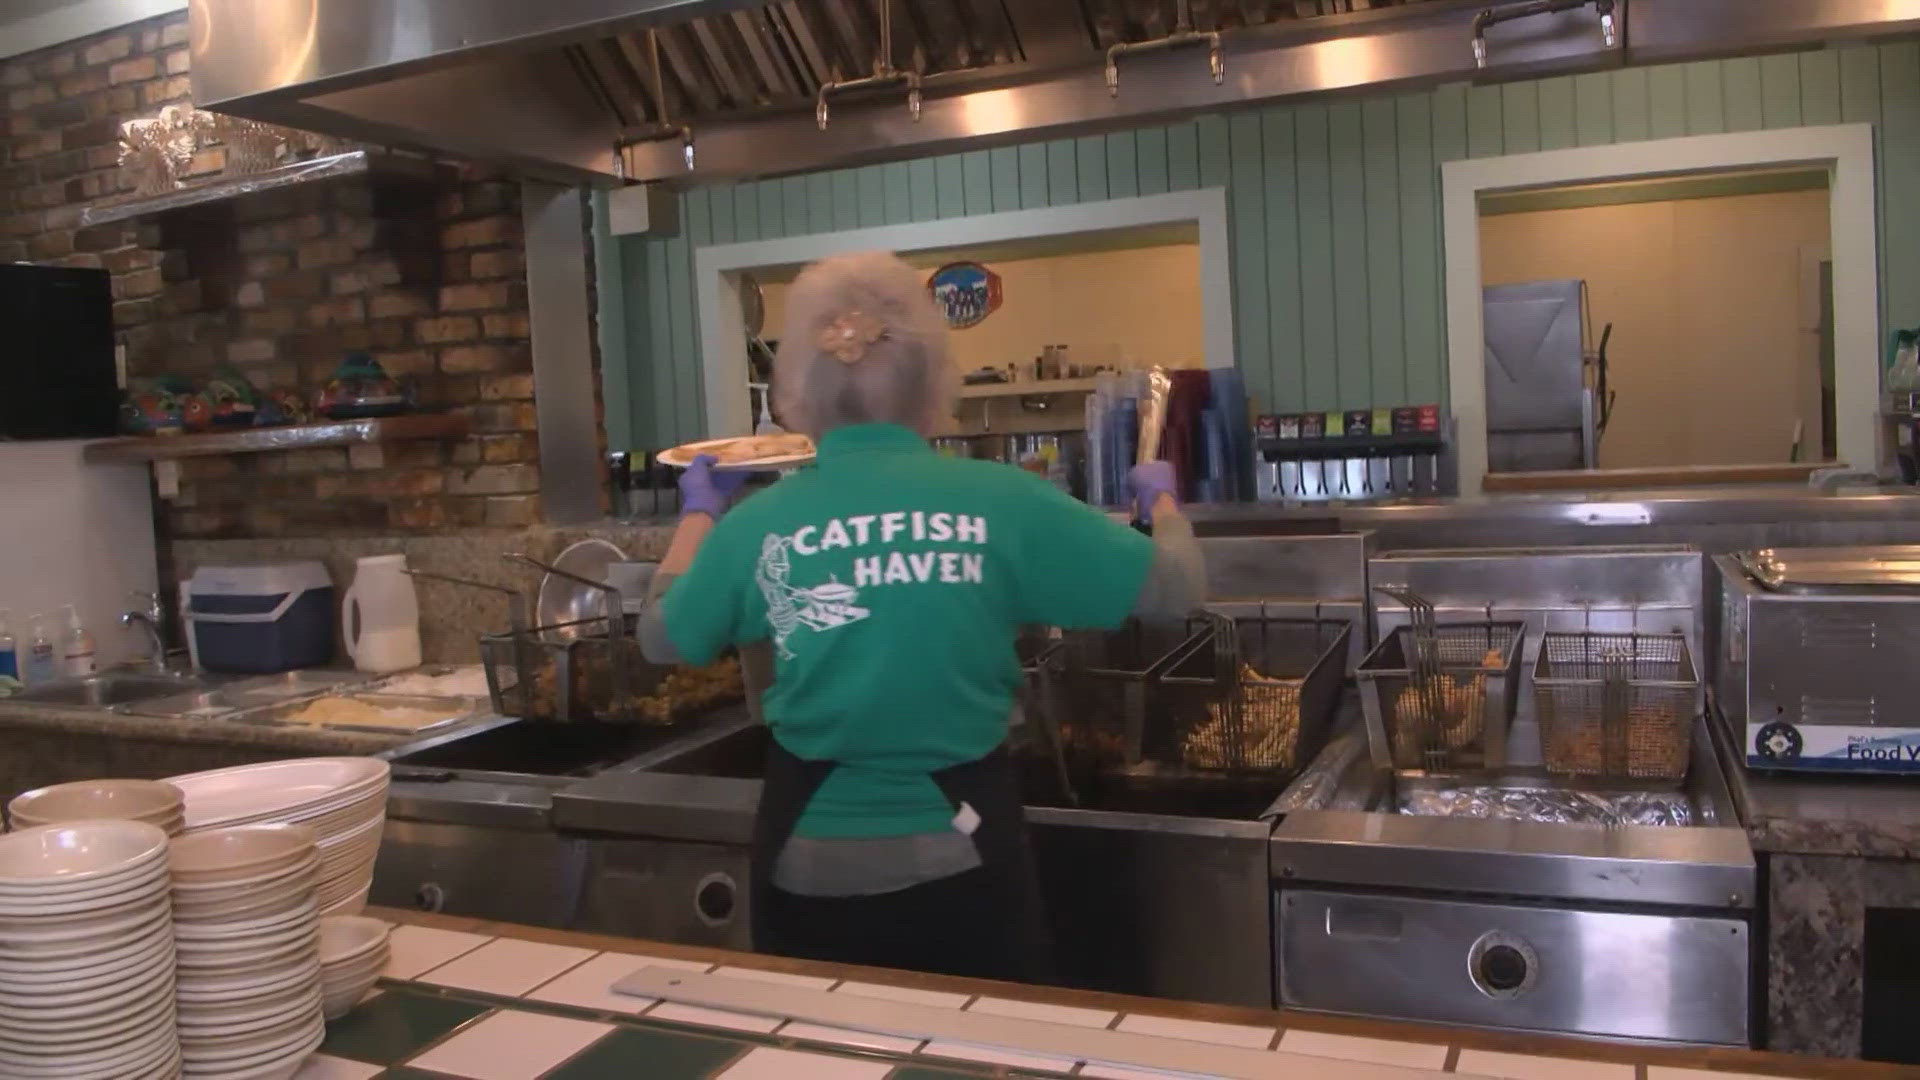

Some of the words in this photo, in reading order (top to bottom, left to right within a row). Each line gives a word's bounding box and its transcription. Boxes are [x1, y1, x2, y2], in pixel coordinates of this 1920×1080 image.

[792, 511, 987, 556] CATFISH
[854, 551, 984, 587] HAVEN
[1847, 743, 1901, 761] Food
